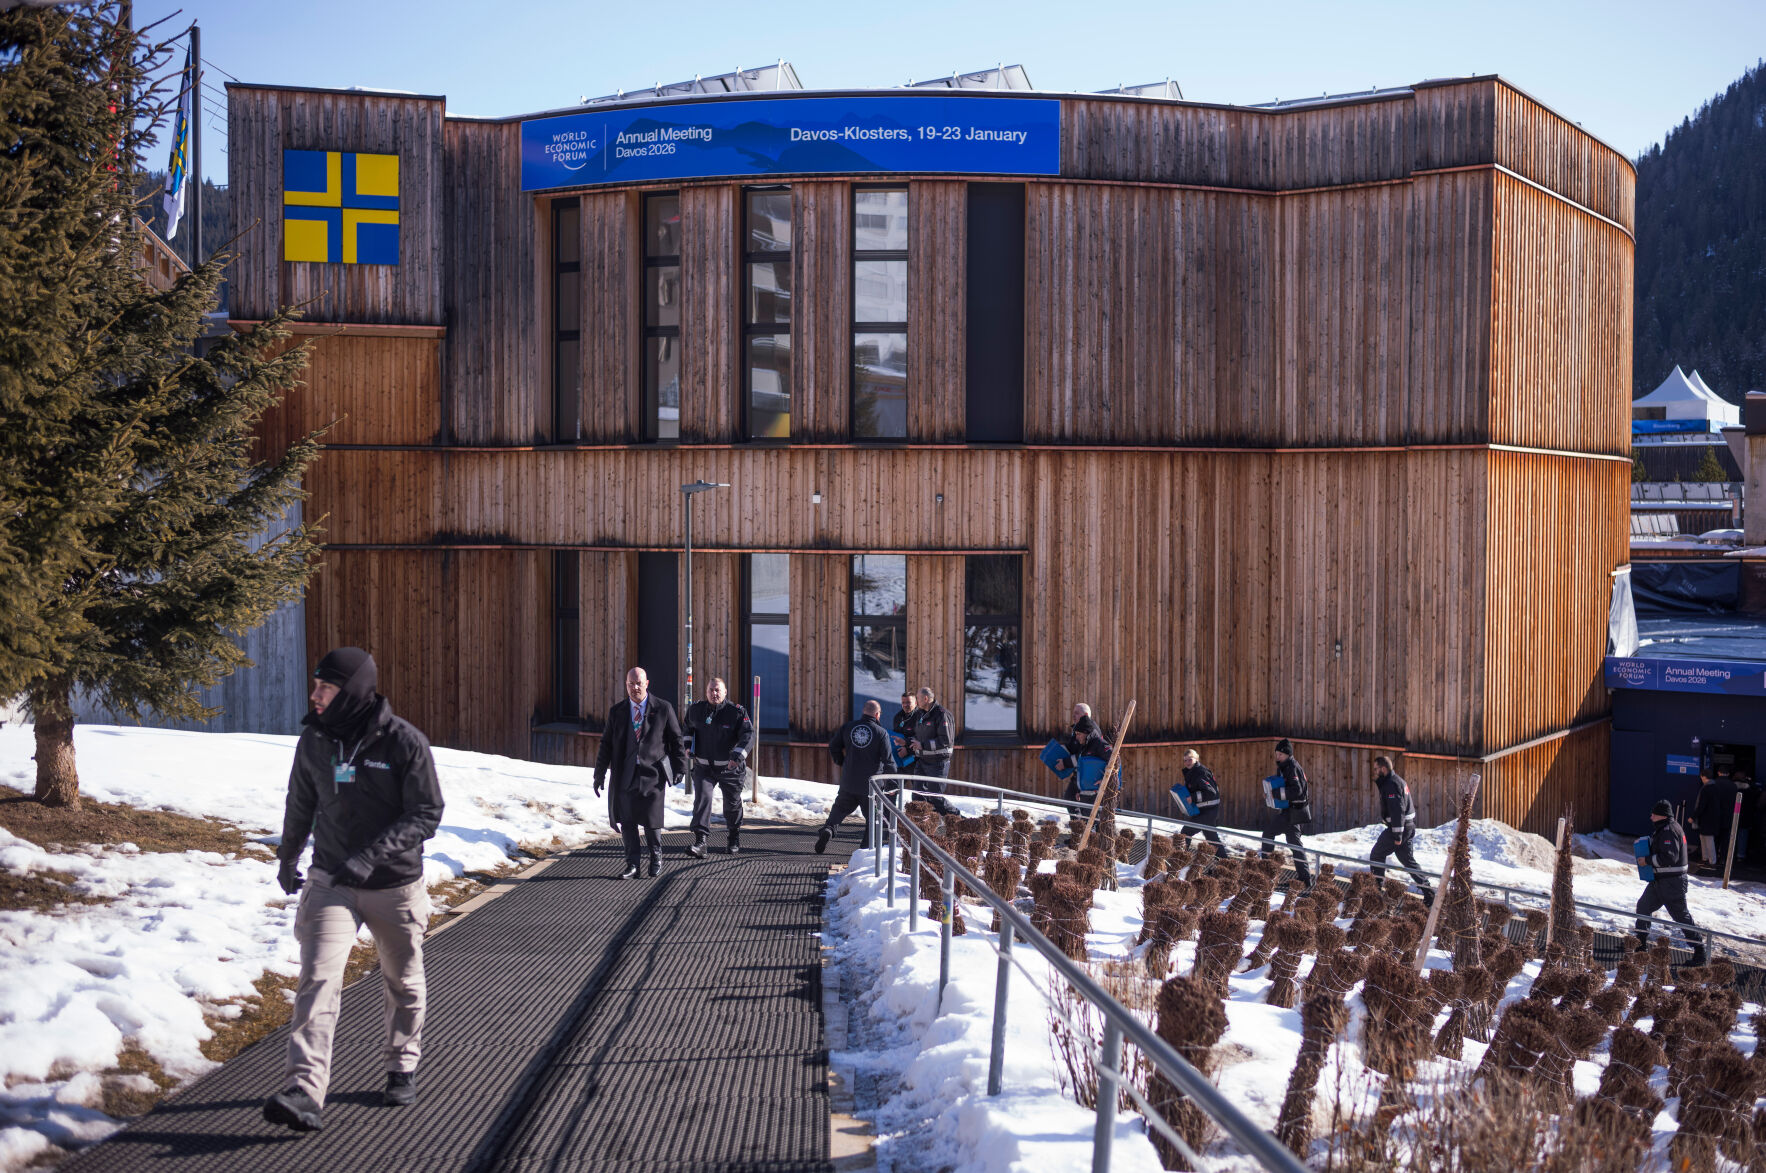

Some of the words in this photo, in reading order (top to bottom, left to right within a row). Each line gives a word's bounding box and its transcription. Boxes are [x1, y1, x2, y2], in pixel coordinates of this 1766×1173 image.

[552, 131, 587, 142] WORLD
[615, 128, 658, 145] Annual
[660, 126, 712, 142] Meeting
[790, 126, 912, 142] Davos-Klosters,
[917, 126, 961, 140] 19-23
[965, 127, 1028, 145] January
[545, 140, 597, 154] ECONOMIC
[615, 146, 647, 158] Davos
[648, 143, 676, 156] 2026
[552, 151, 587, 162] FORUM
[1618, 661, 1645, 669] WORLD
[1613, 667, 1652, 675] ECONOMIC
[1665, 667, 1695, 676] Annual
[1696, 668, 1731, 679] Meeting
[1665, 675, 1687, 683] Davos
[1688, 676, 1707, 684] 2026
